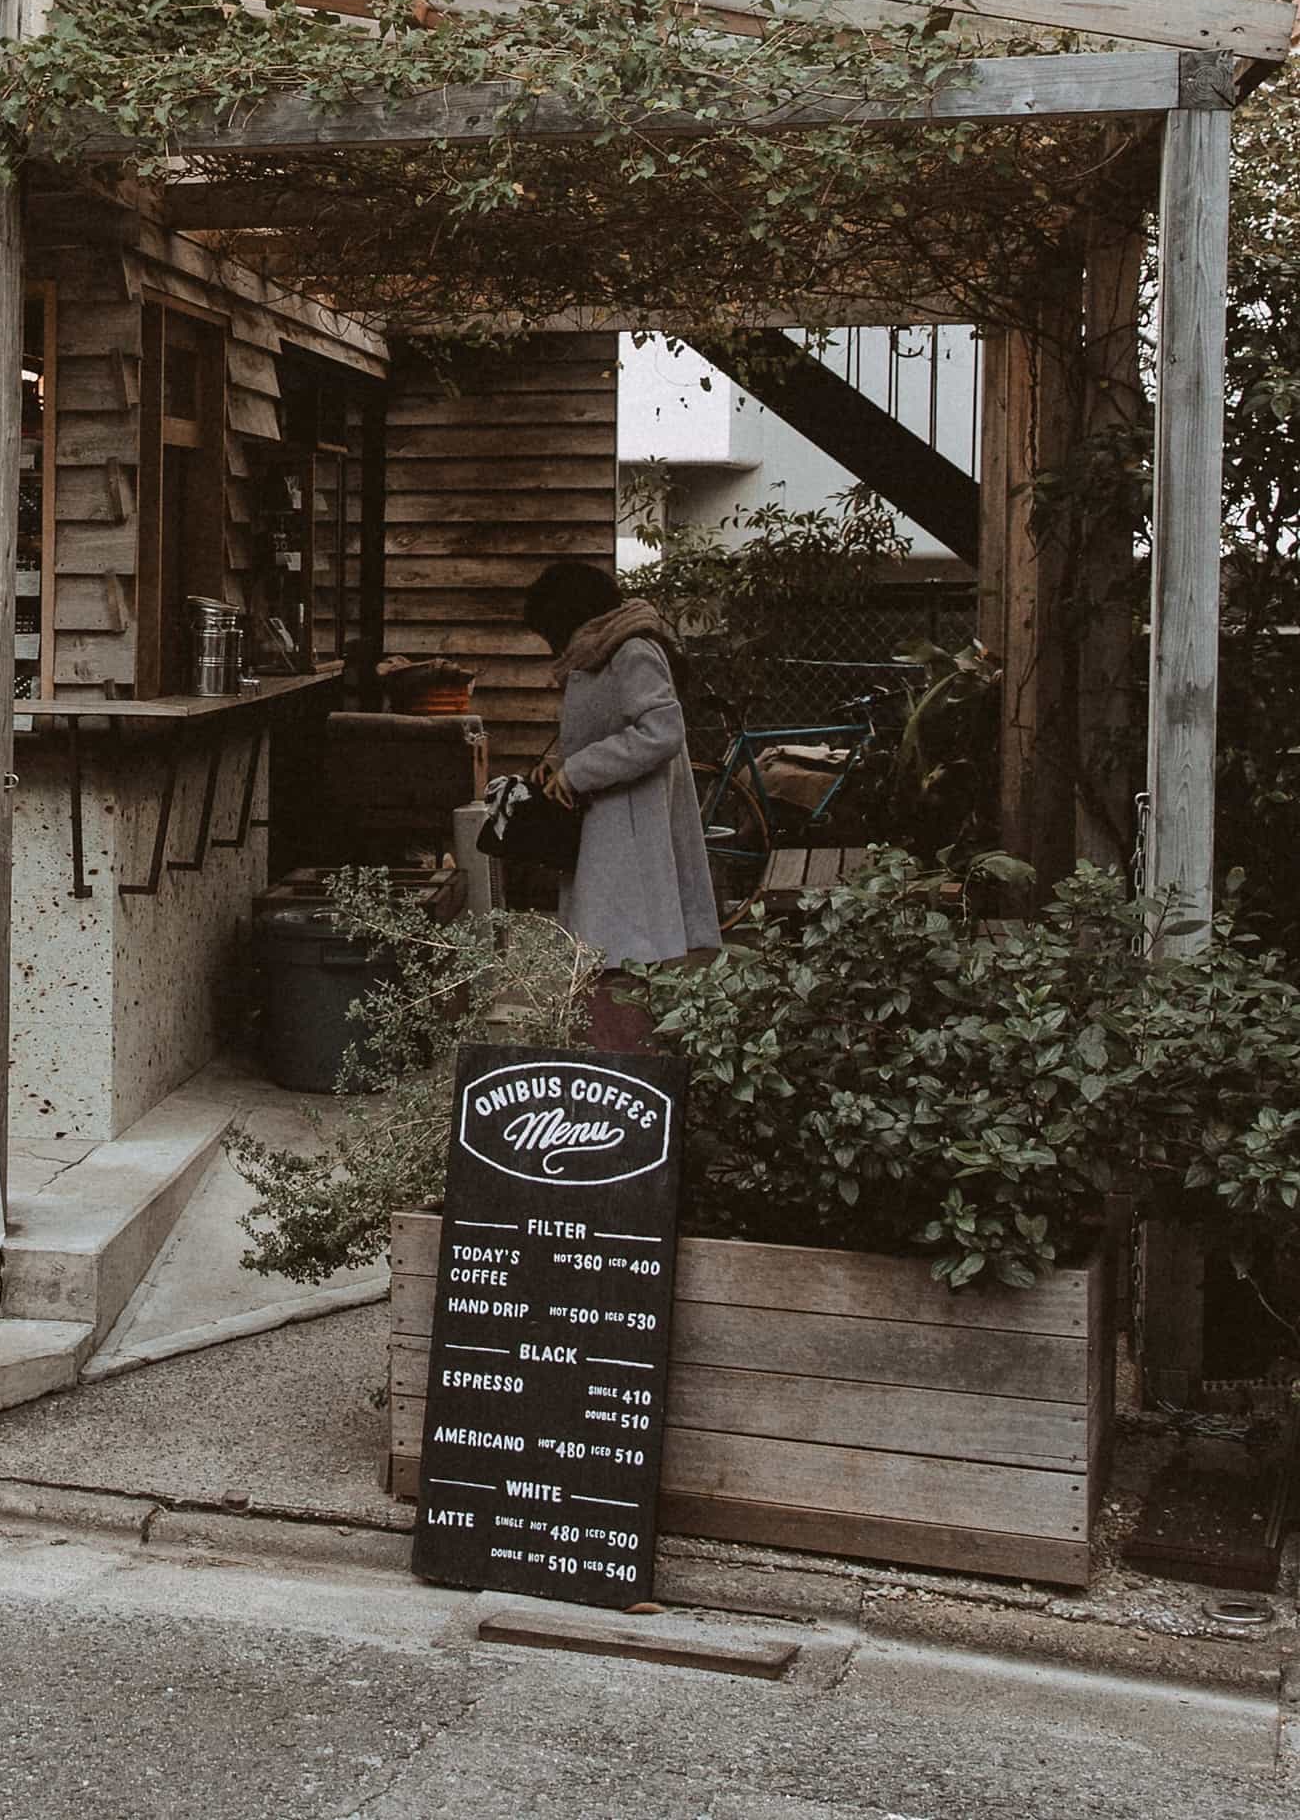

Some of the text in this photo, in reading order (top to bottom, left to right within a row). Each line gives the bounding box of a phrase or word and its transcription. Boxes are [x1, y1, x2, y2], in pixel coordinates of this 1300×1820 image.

[475, 1076, 657, 1129] ONIBUS COFFEE
[503, 1107, 625, 1174] Menu
[528, 1219, 586, 1239] FILTER
[453, 1245, 660, 1275] TODAY'S HOT 360 ICED 400
[451, 1268, 508, 1286] COFFEE
[449, 1298, 656, 1330] HAND DRIP HOT 500 ICED 530
[520, 1344, 577, 1364] BLACK
[443, 1370, 651, 1405] ESPRESSO SINGLE 410
[585, 1410, 649, 1430] DOUBLE 510
[434, 1426, 643, 1465] AMERICANO HOT 480 ICED 510
[506, 1480, 561, 1502] WHITE
[428, 1508, 638, 1549] LATTE SINGLE HOT 480 ICED 500
[491, 1548, 636, 1582] DOUBLE HOT 510 ICED 540
